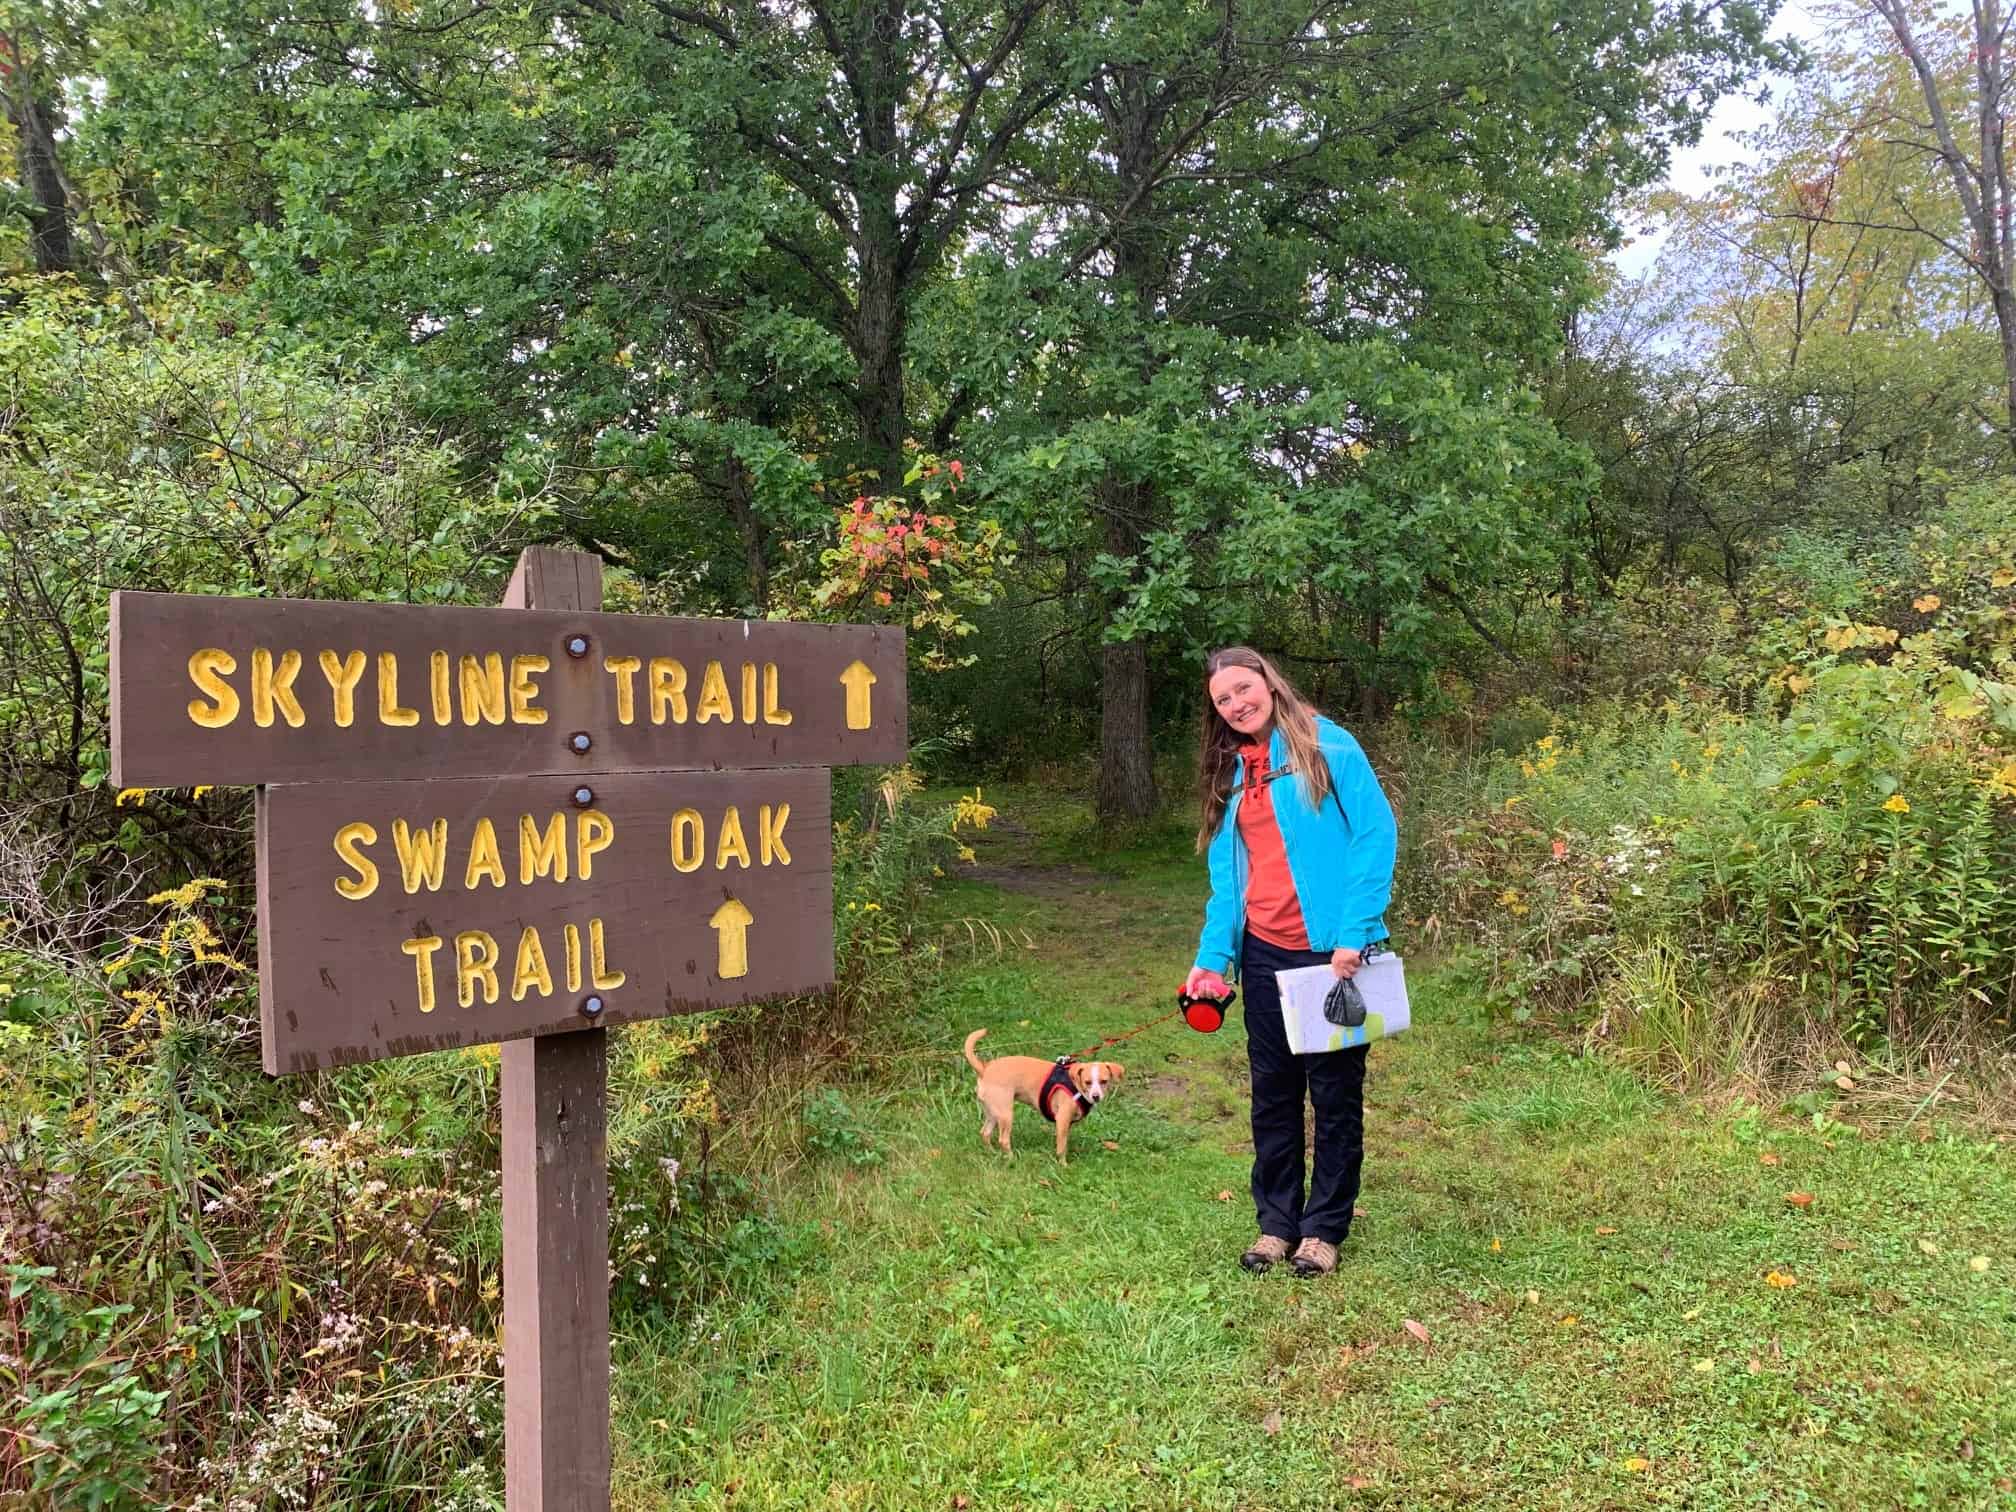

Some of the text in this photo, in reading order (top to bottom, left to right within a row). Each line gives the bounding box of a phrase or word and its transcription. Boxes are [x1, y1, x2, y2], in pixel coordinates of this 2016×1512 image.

[187, 647, 793, 729] SKYLINE TRAIL
[333, 803, 792, 901] SWAMP OAK
[401, 917, 627, 1014] TRAIL
